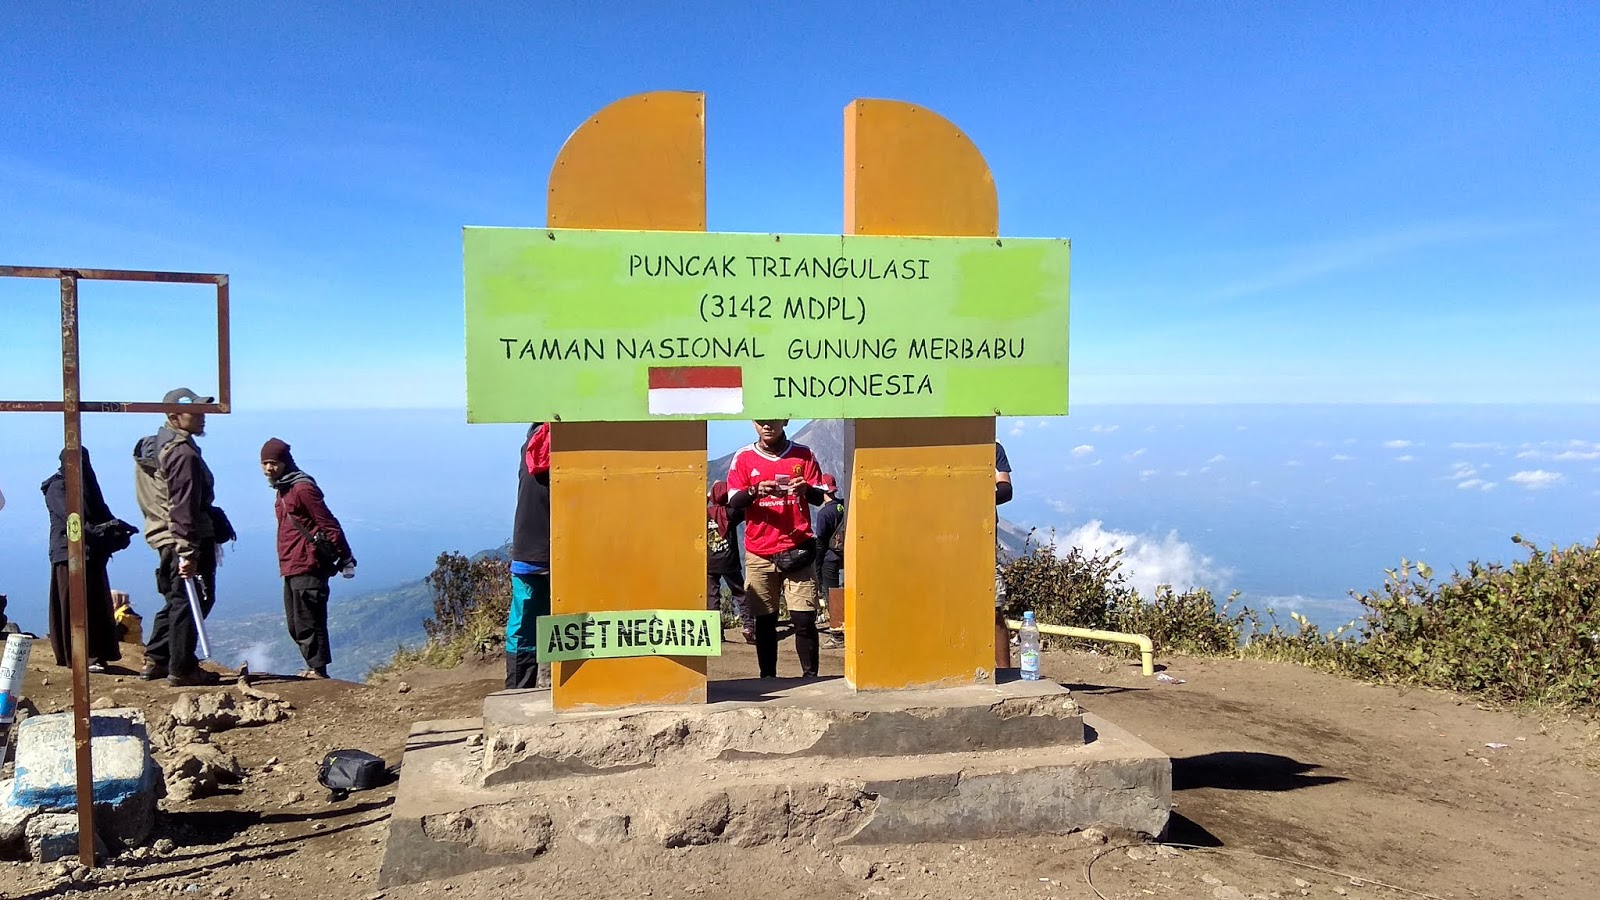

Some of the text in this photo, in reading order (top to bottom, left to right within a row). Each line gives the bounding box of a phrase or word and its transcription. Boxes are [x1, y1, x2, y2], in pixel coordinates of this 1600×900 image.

[630, 255, 930, 280] PUNCAK TRIANGULASI
[700, 294, 866, 325] (3142 MDPL)
[500, 337, 1025, 361] TAMAN NASIONAL GUNUNG MERBABU
[773, 374, 933, 398] INDONESIA
[548, 618, 711, 654] ASET NEGARA
